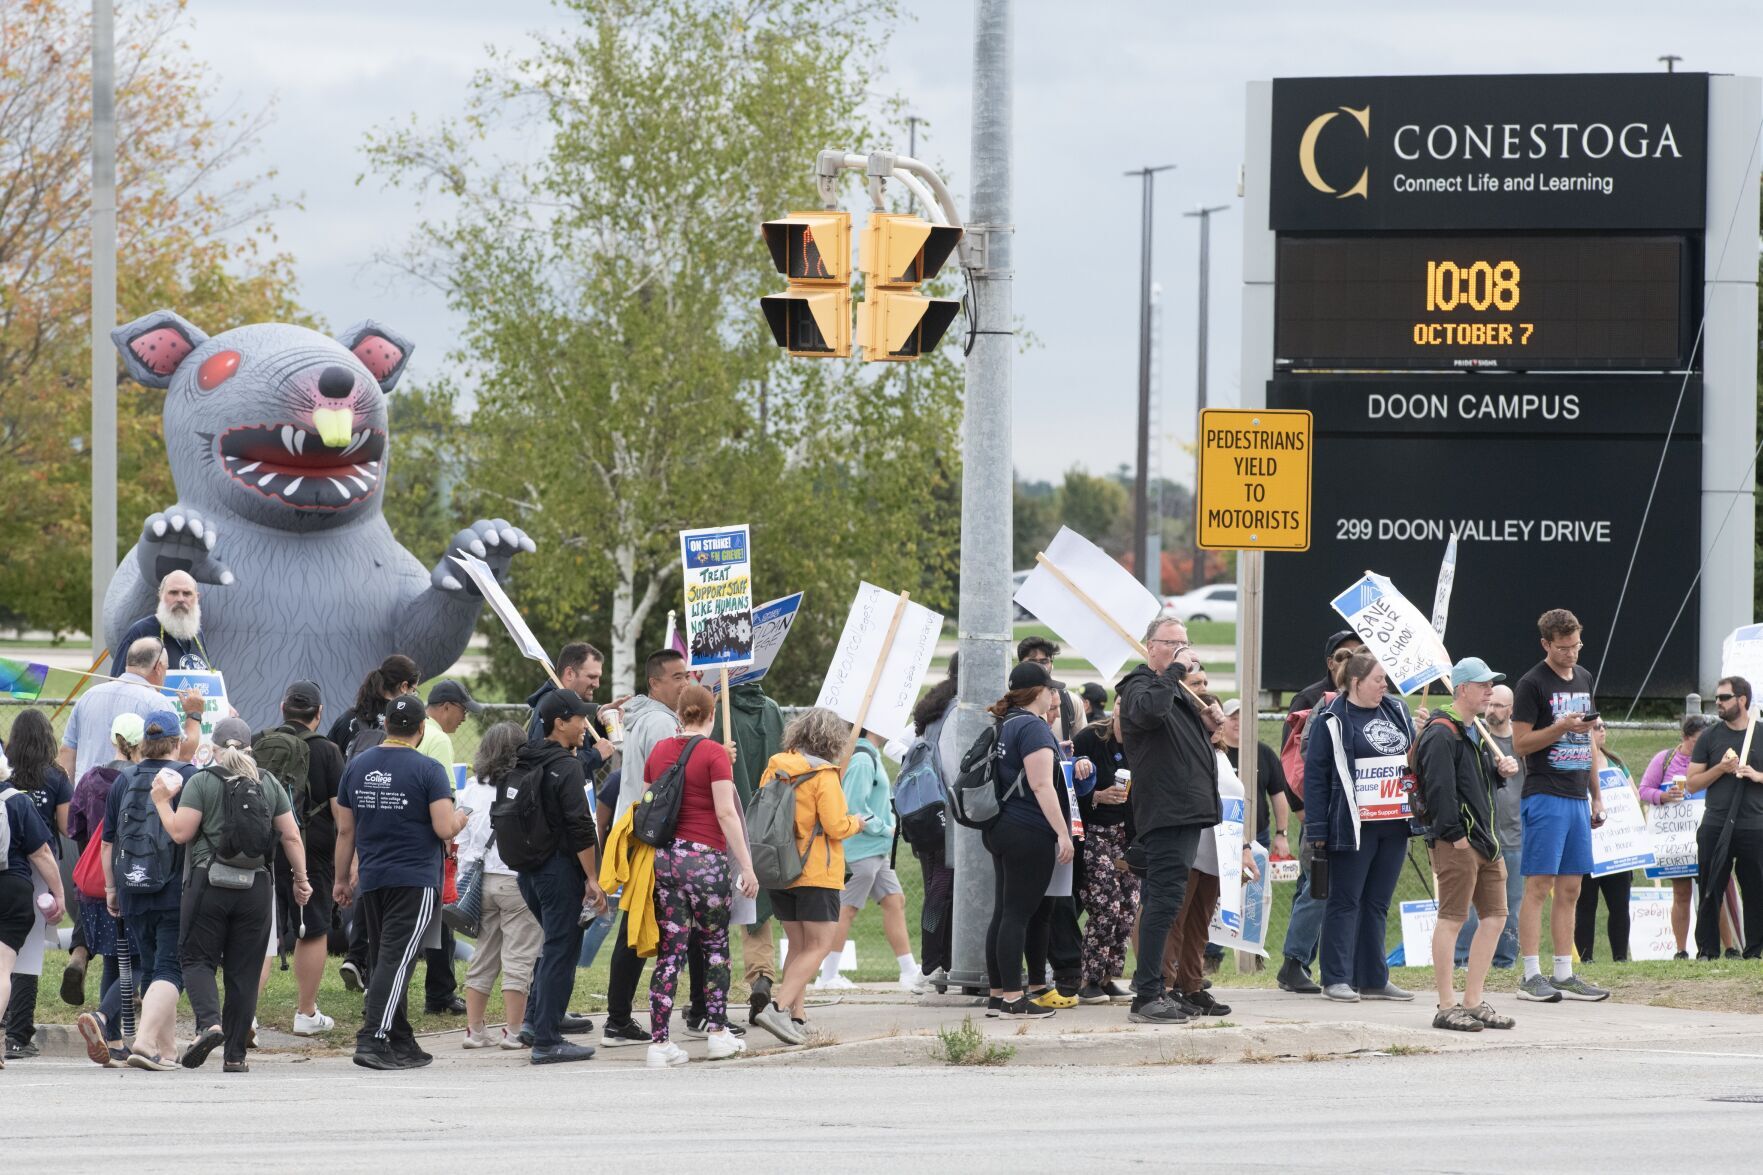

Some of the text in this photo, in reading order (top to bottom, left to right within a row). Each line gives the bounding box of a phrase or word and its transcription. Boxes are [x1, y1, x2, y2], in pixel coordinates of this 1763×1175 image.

[1393, 123, 1682, 160] CONESTOGA
[1393, 173, 1614, 194] Connect Life and Learning
[1426, 261, 1521, 311] 10:08
[1413, 323, 1534, 345] OCTOBER 7
[1368, 394, 1581, 420] DOON CAMPUS
[1207, 430, 1305, 451] PEDESTRIANS
[1233, 457, 1277, 477] YIELD
[1244, 483, 1266, 503] TO
[1208, 509, 1300, 530] MOTORISTS
[1336, 518, 1611, 542] 299 DOON VALLEY DRIVE
[690, 536, 731, 552] ON STRIKE!
[700, 565, 731, 583] TREAT
[688, 577, 748, 602] SUPPORT STAFF
[691, 601, 713, 617] LIKE
[715, 596, 749, 615] HUMANS
[691, 618, 707, 634] NOT
[1356, 599, 1391, 639] SAVE
[1377, 610, 1401, 644] OUR
[696, 616, 724, 649] SPARE
[365, 774, 392, 784] College
[1354, 766, 1395, 781] OLLEGES
[1354, 783, 1379, 792] cause
[1377, 809, 1399, 817] Support
[1653, 803, 1693, 820] OUR JOB
[1655, 820, 1699, 835] SECURITY
[1654, 842, 1696, 855] STUDENT
[1656, 855, 1698, 867] SECURITY
[1631, 903, 1669, 922] lleges!
[1649, 940, 1674, 952] ave
